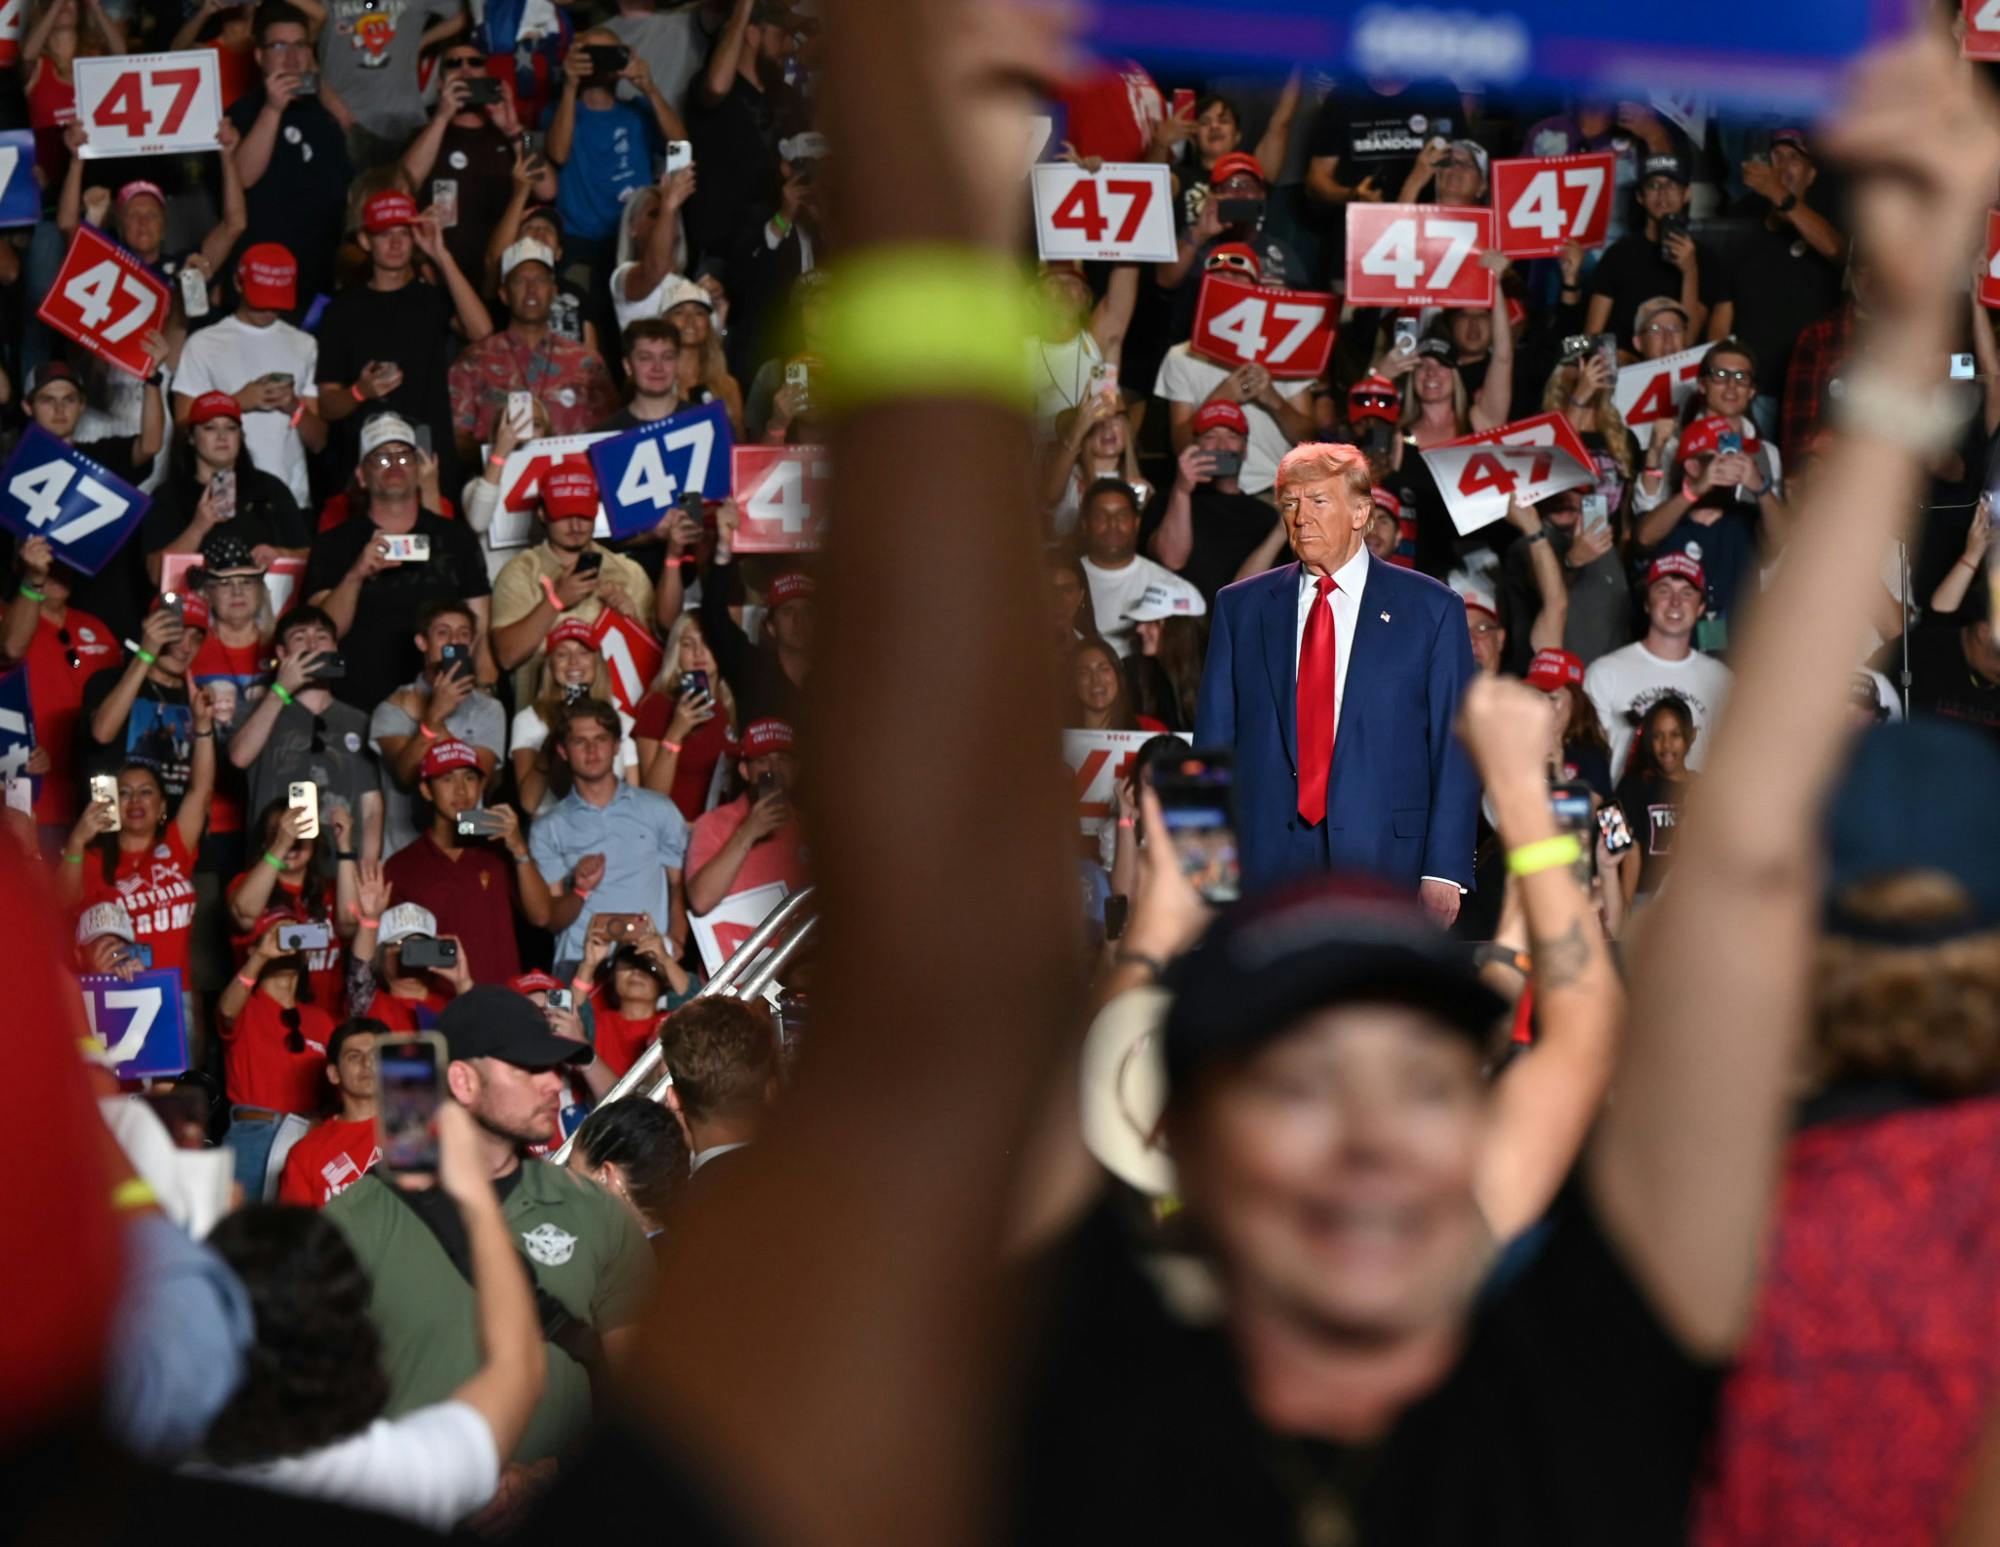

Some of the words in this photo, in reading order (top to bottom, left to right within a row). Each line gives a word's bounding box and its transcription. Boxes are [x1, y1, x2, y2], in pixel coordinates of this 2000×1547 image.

[93, 67, 201, 137] 47
[1353, 137, 1423, 152] BRANDON
[1051, 179, 1153, 242] 47
[1507, 167, 1605, 239] 47
[1361, 219, 1478, 289] 47
[64, 258, 158, 344] 47
[1208, 297, 1326, 363] 47
[616, 419, 715, 509] 47
[747, 461, 832, 533] 4
[1458, 450, 1553, 497] 47
[8, 458, 130, 545] 47
[437, 751, 459, 764] GREAT
[753, 731, 775, 745] GREAT
[82, 987, 162, 1061] 7
